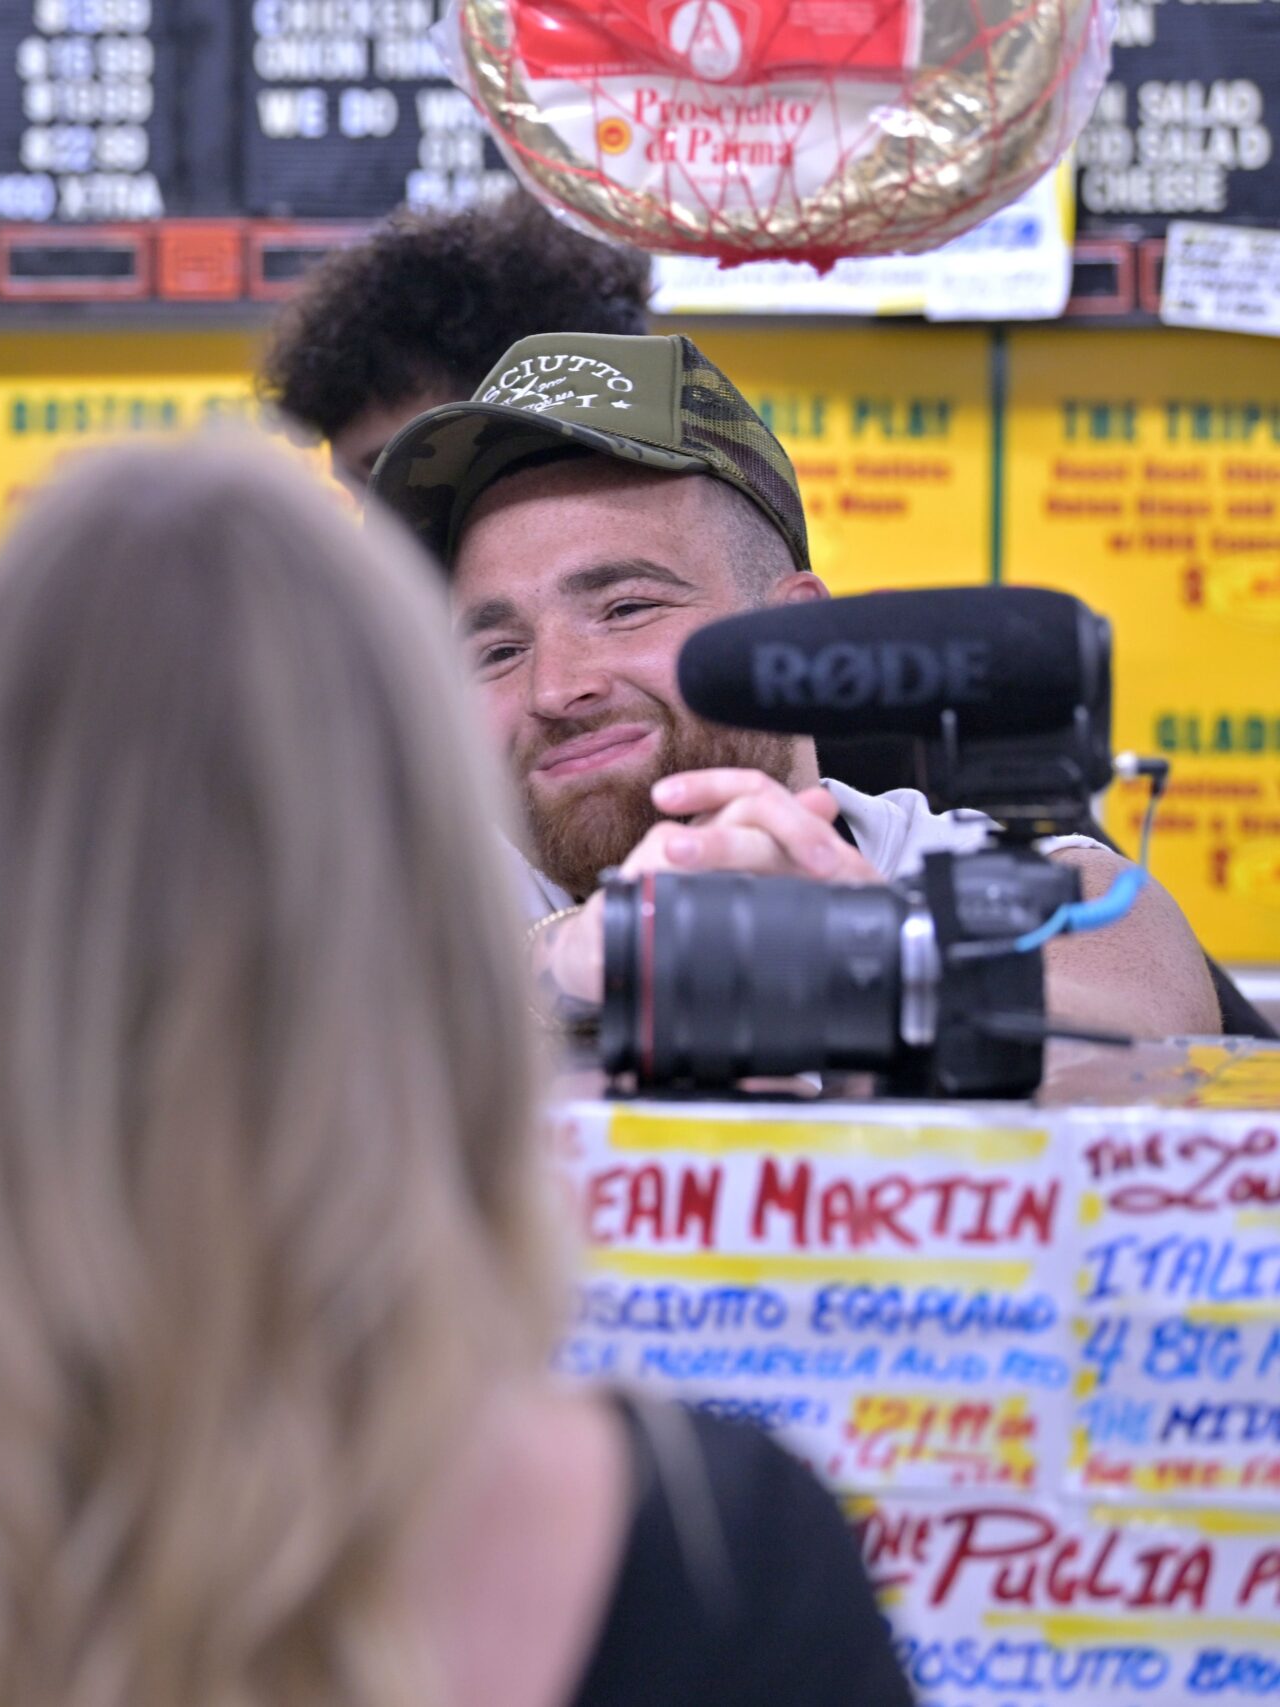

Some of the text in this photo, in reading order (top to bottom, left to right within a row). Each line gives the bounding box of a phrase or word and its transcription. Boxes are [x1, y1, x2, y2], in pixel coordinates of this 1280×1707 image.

[259, 90, 326, 136] WE
[340, 90, 397, 136] DO
[632, 87, 813, 126] Prosciutto
[1139, 81, 1263, 126] SALAD
[645, 128, 796, 167] di Parma
[1138, 124, 1272, 169] SALAD
[1082, 166, 1227, 212] CHEESE
[586, 1154, 1061, 1250] EAN MARTIN
[1083, 1232, 1280, 1305] ITALI
[1082, 1316, 1130, 1385] 4
[1142, 1315, 1245, 1382] BIG
